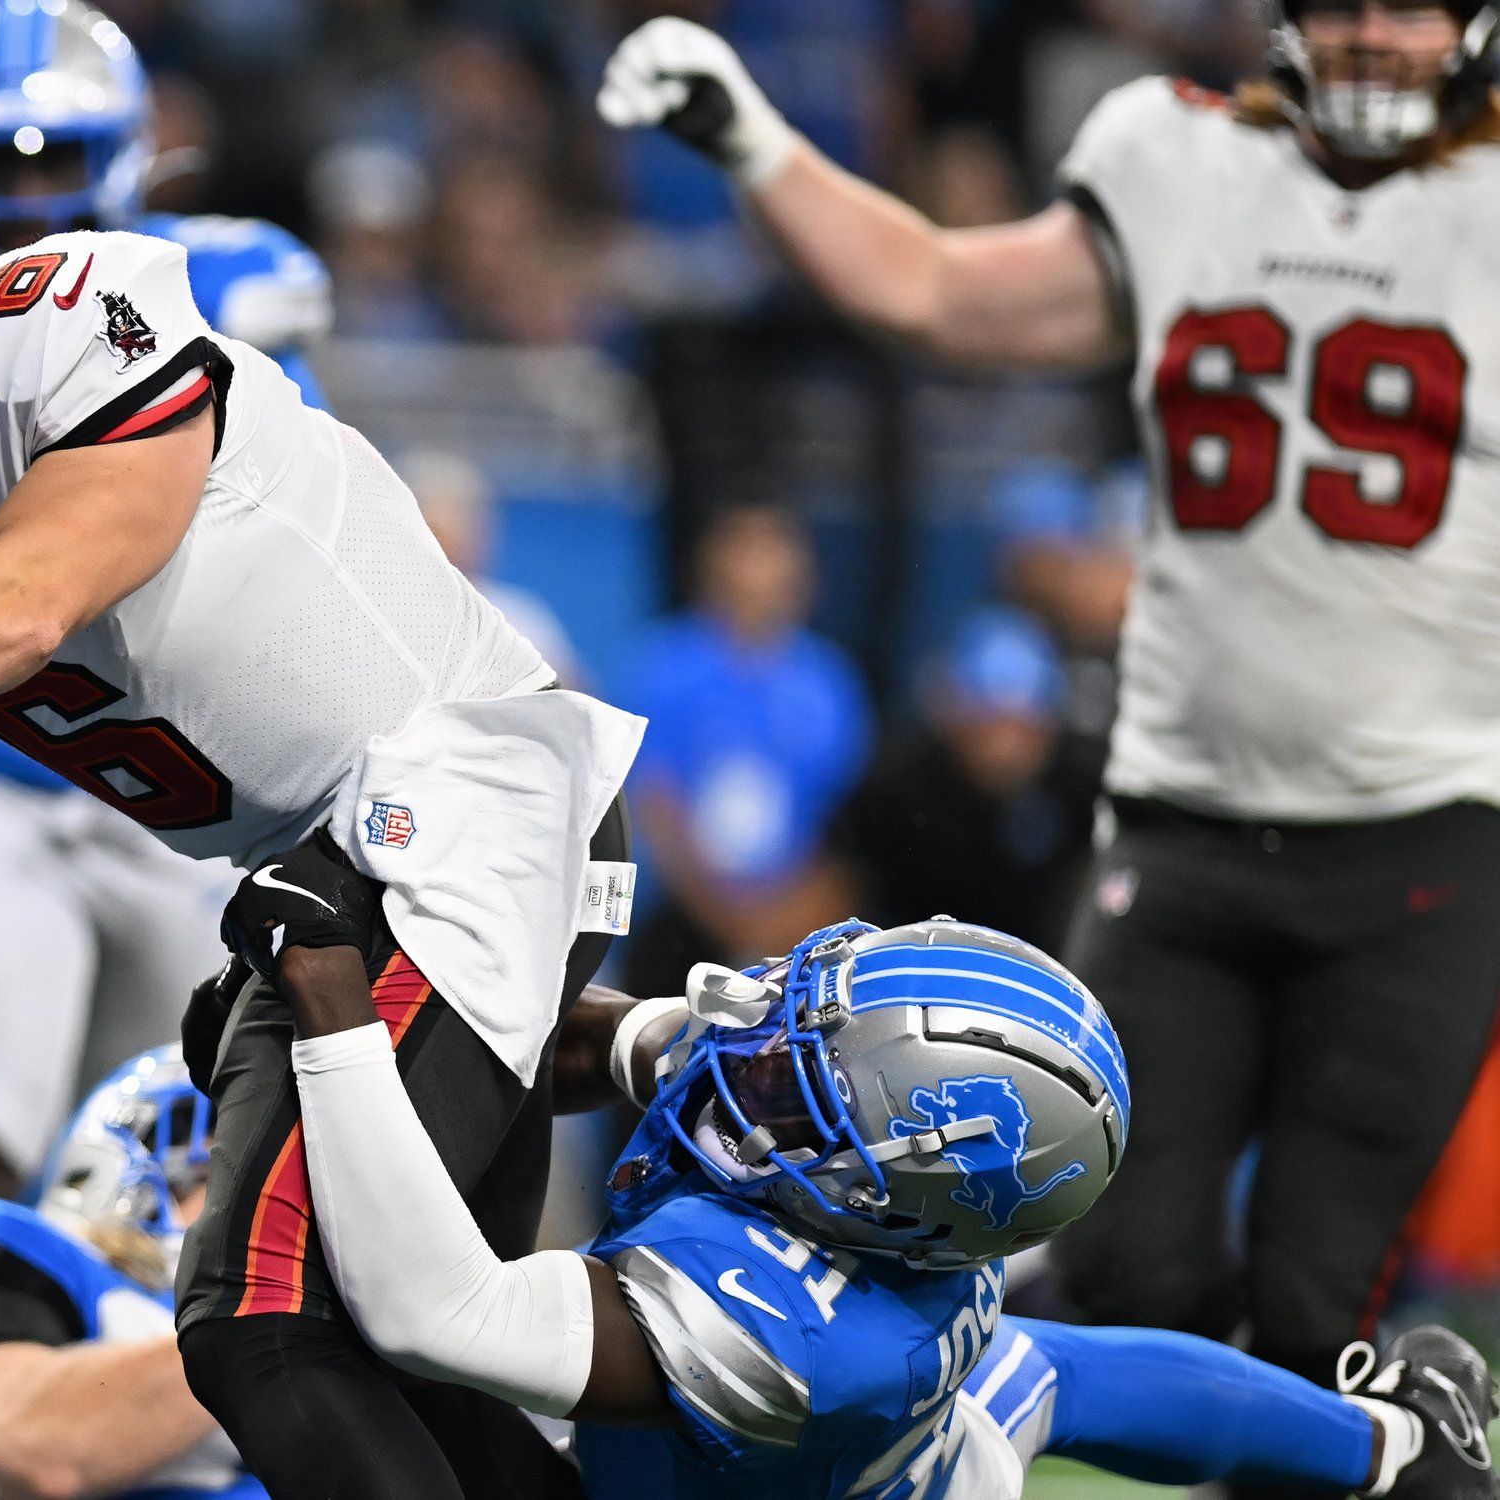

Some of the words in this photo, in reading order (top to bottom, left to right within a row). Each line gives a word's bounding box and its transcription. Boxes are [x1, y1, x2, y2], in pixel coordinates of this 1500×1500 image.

[1153, 304, 1468, 553] 69
[385, 811, 412, 846] NFL
[604, 876, 616, 921] northwest
